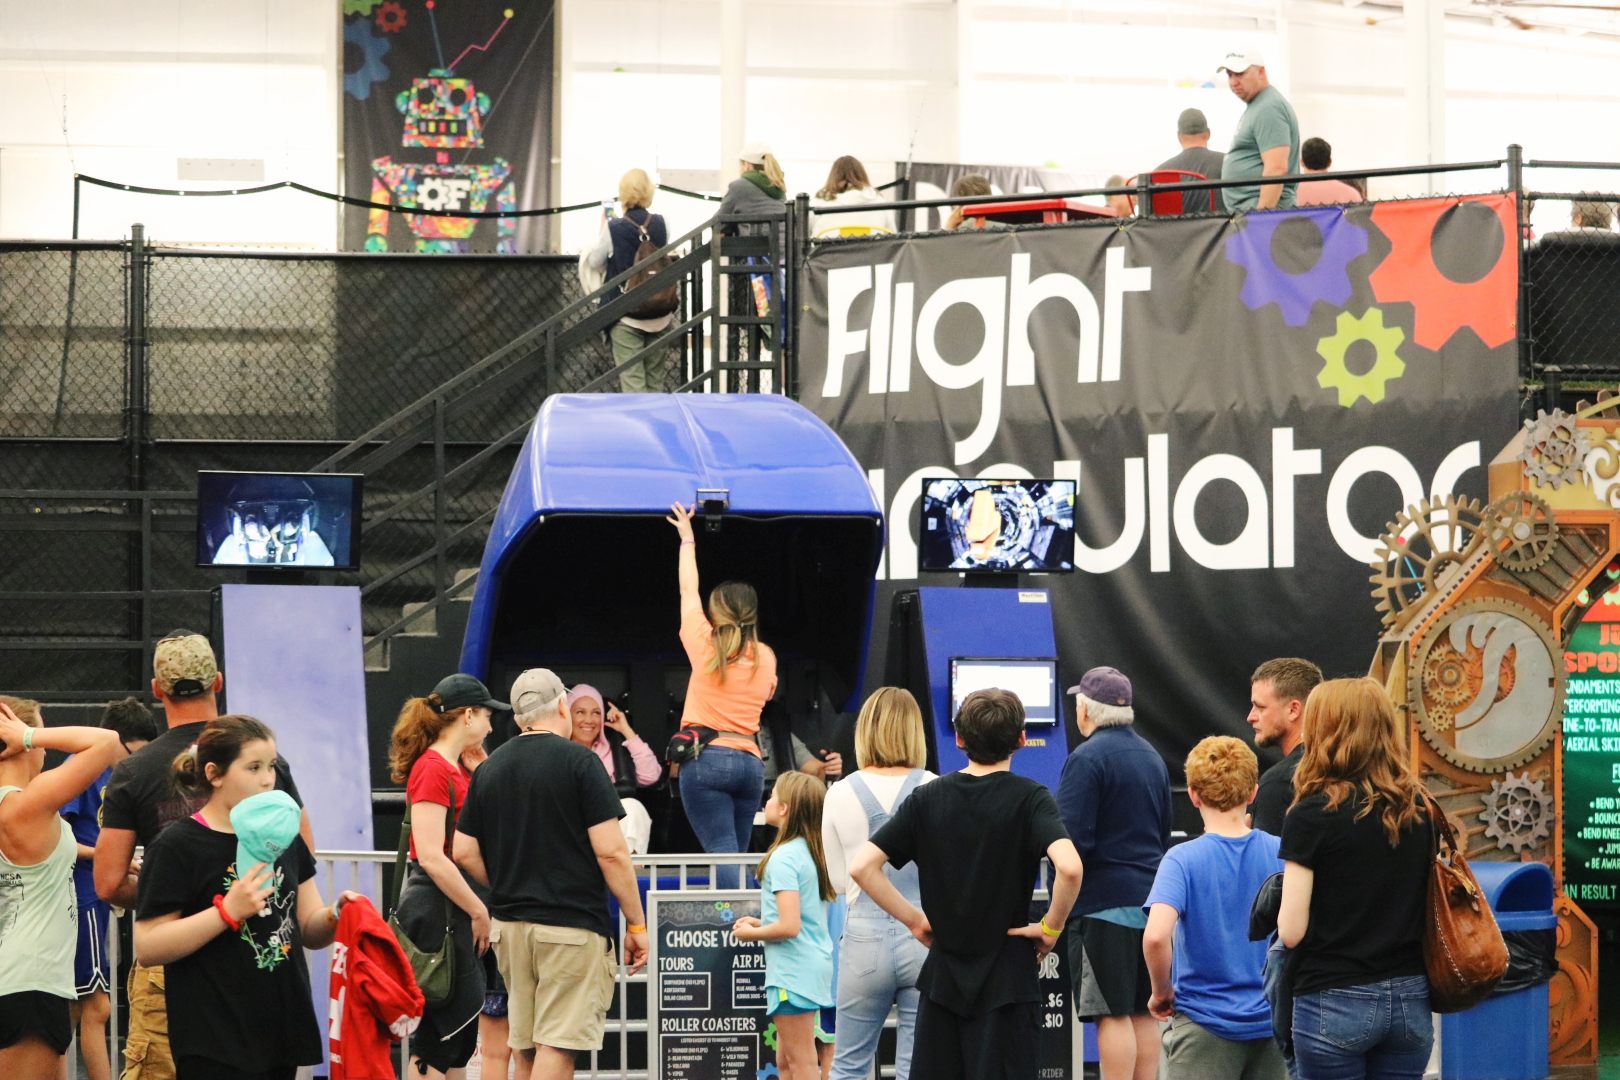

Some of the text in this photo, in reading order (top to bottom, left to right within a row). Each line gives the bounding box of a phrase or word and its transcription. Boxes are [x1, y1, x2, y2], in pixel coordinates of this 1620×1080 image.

[822, 246, 1152, 466] Flight
[1564, 652, 1620, 673] SPO
[1566, 737, 1620, 752] AERIAL SKI
[1595, 797, 1615, 809] BEND
[1583, 827, 1620, 839] BEND KNEE
[1591, 857, 1600, 869] BE
[1581, 884, 1617, 900] RESULT
[666, 930, 719, 948] CHOOSE
[659, 957, 694, 971] TOURS
[732, 954, 752, 968] AIR
[661, 1017, 756, 1032] ROLLER COASTERS
[1041, 1068, 1063, 1079] RIDER
